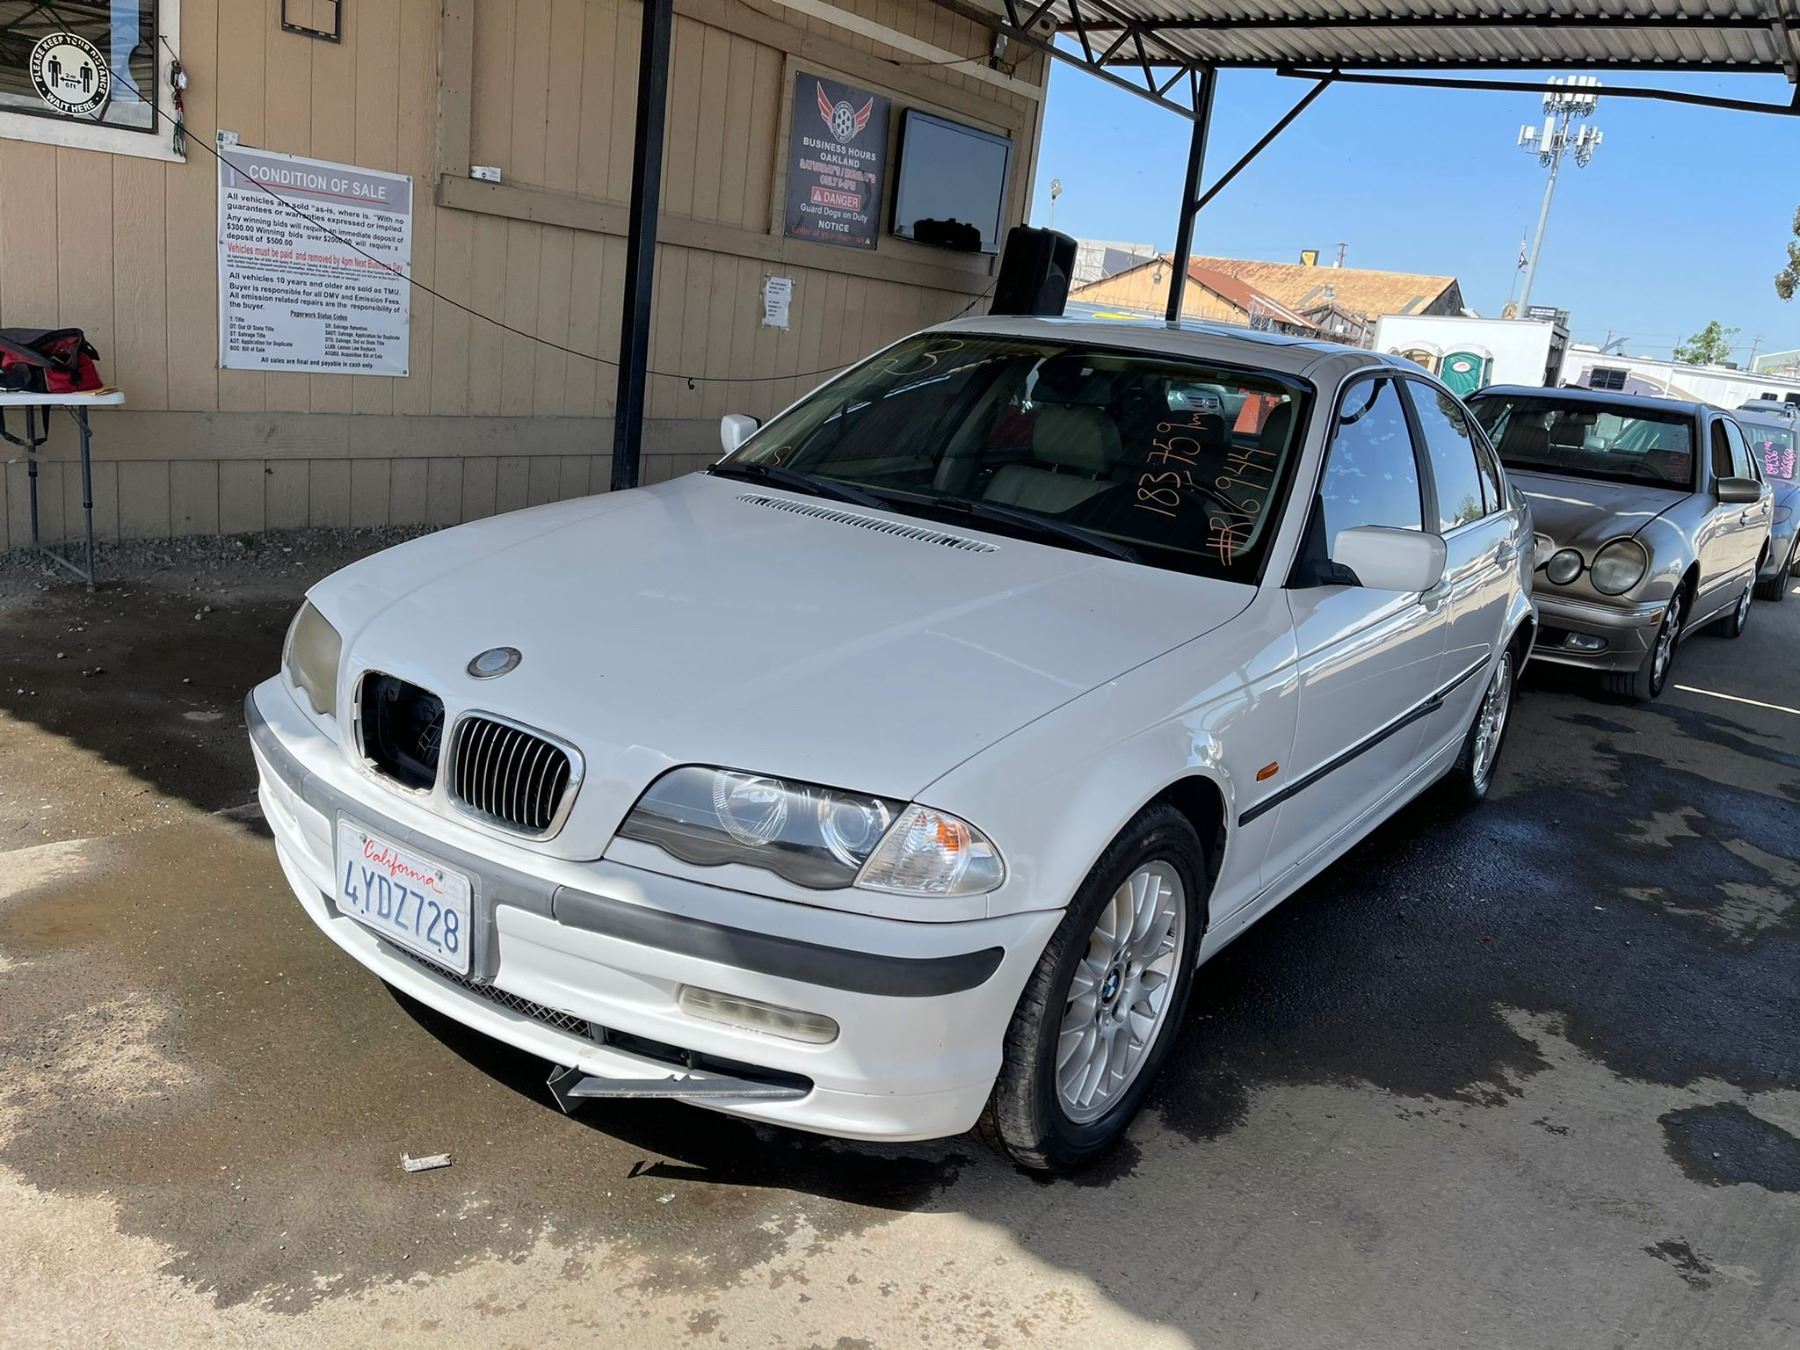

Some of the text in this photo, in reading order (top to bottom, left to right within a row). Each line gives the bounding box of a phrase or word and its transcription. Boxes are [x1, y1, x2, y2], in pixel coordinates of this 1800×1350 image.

[33, 36, 106, 94] PLEASE KEEP YOUR DISTANCE
[46, 92, 96, 112] WAIT HERE
[803, 137, 876, 160] BUSINESS HOURS
[820, 153, 860, 168] OAKLAND
[249, 165, 386, 199] CONDITION OF SALE
[227, 192, 238, 200] All
[241, 194, 274, 205] vehicles
[338, 210, 360, 218] where
[824, 192, 858, 208] DANGER
[227, 202, 272, 214] guarantees
[327, 216, 365, 228] expressed
[800, 203, 822, 214] Guard
[824, 207, 841, 219] Dogs
[852, 213, 868, 224] Duty
[226, 214, 241, 222] Any
[242, 215, 272, 227] winning
[273, 220, 288, 228] bids
[338, 229, 371, 239] immediate
[372, 233, 395, 243] deposit
[227, 223, 254, 232] $300.00
[256, 226, 285, 237] Winning
[288, 230, 303, 239] bids
[369, 242, 391, 250] require
[818, 220, 849, 232] NOTICE
[227, 232, 253, 241] deposit
[267, 236, 293, 246] $500.00
[228, 242, 253, 255] Vehicles
[255, 247, 270, 256] must
[272, 248, 279, 258] be
[280, 250, 293, 260] paid
[242, 274, 274, 283] vehicles
[287, 279, 307, 287] years
[309, 280, 322, 288] and
[325, 282, 343, 290] older
[229, 283, 251, 291] Buyer
[261, 287, 301, 295] responsible
[354, 295, 383, 303] Emission
[241, 293, 273, 302] emission
[275, 296, 298, 304] related
[351, 304, 392, 313] responsibility
[364, 839, 444, 895] California
[344, 860, 459, 954] 4YDZ728
